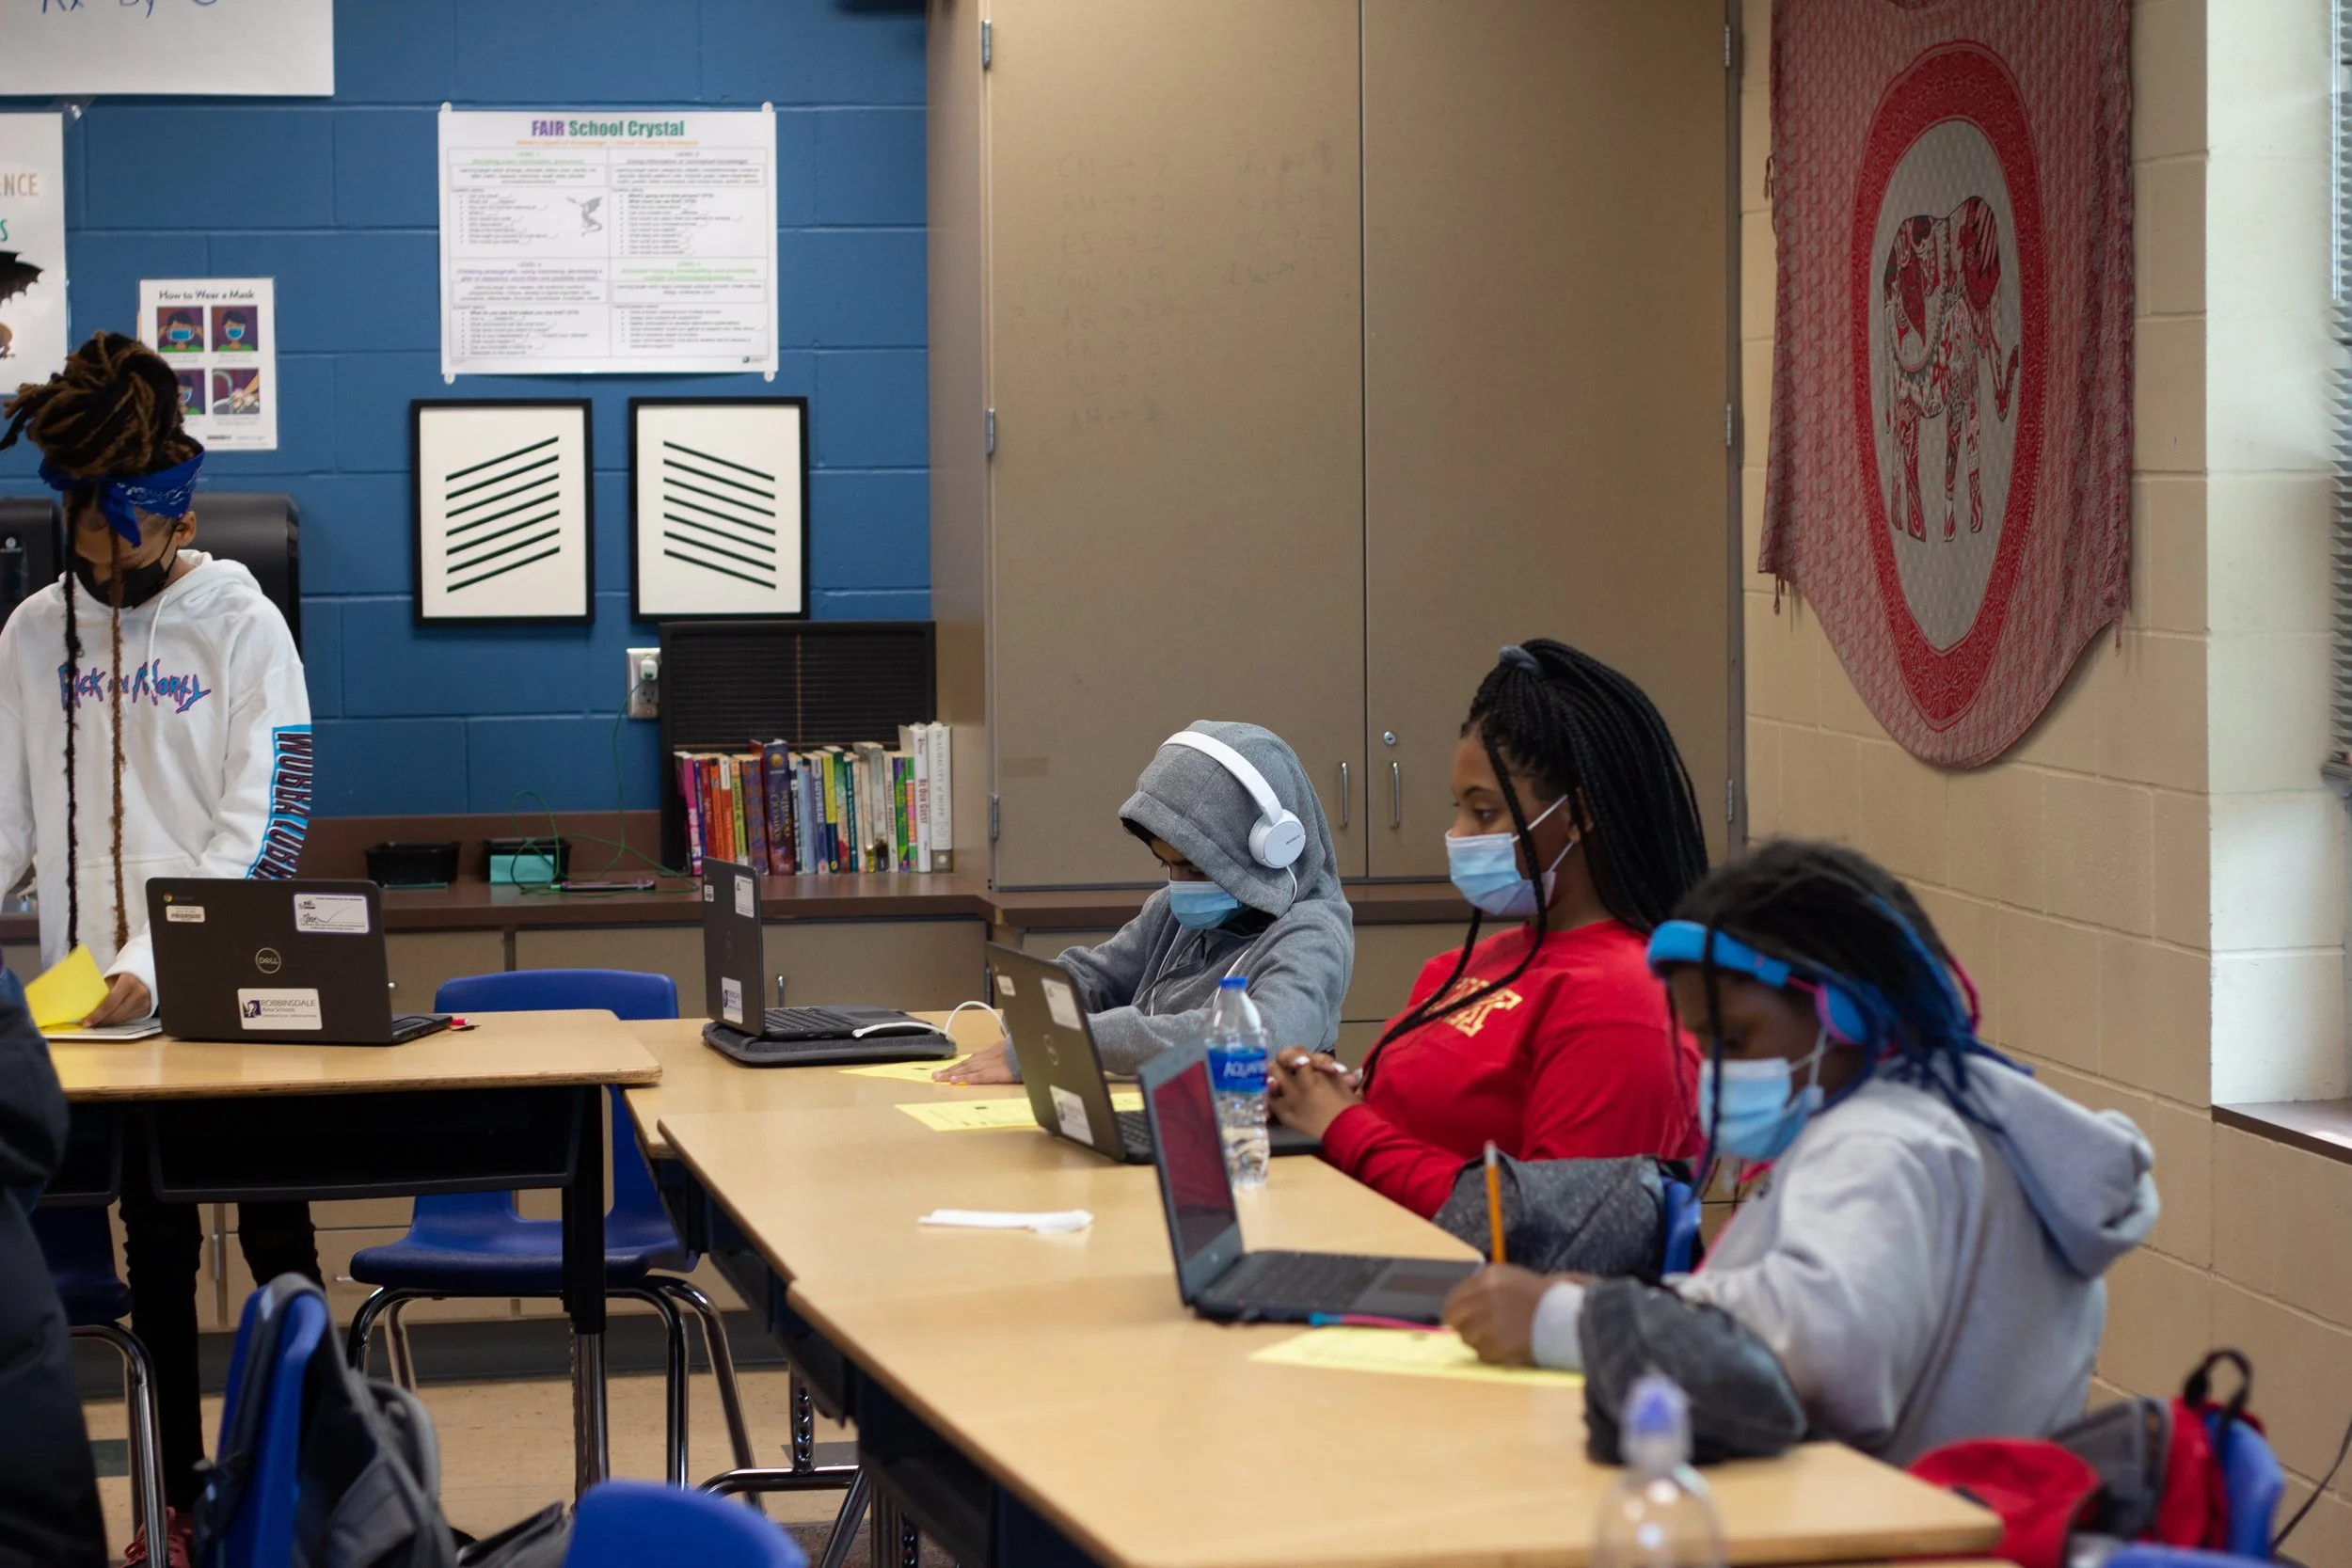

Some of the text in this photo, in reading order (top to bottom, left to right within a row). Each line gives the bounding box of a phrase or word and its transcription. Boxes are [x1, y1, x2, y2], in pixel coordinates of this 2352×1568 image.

[531, 119, 686, 138] FAIR School Crystal
[0, 172, 39, 198] NCE
[159, 289, 182, 300] How
[183, 291, 193, 299] to
[195, 289, 220, 300] Wear
[229, 289, 255, 299] Mask
[273, 731, 313, 818] WUBBA
[1285, 833, 1300, 845] SONY
[258, 957, 279, 965] DELL
[261, 999, 316, 1007] ROBBINSDALE
